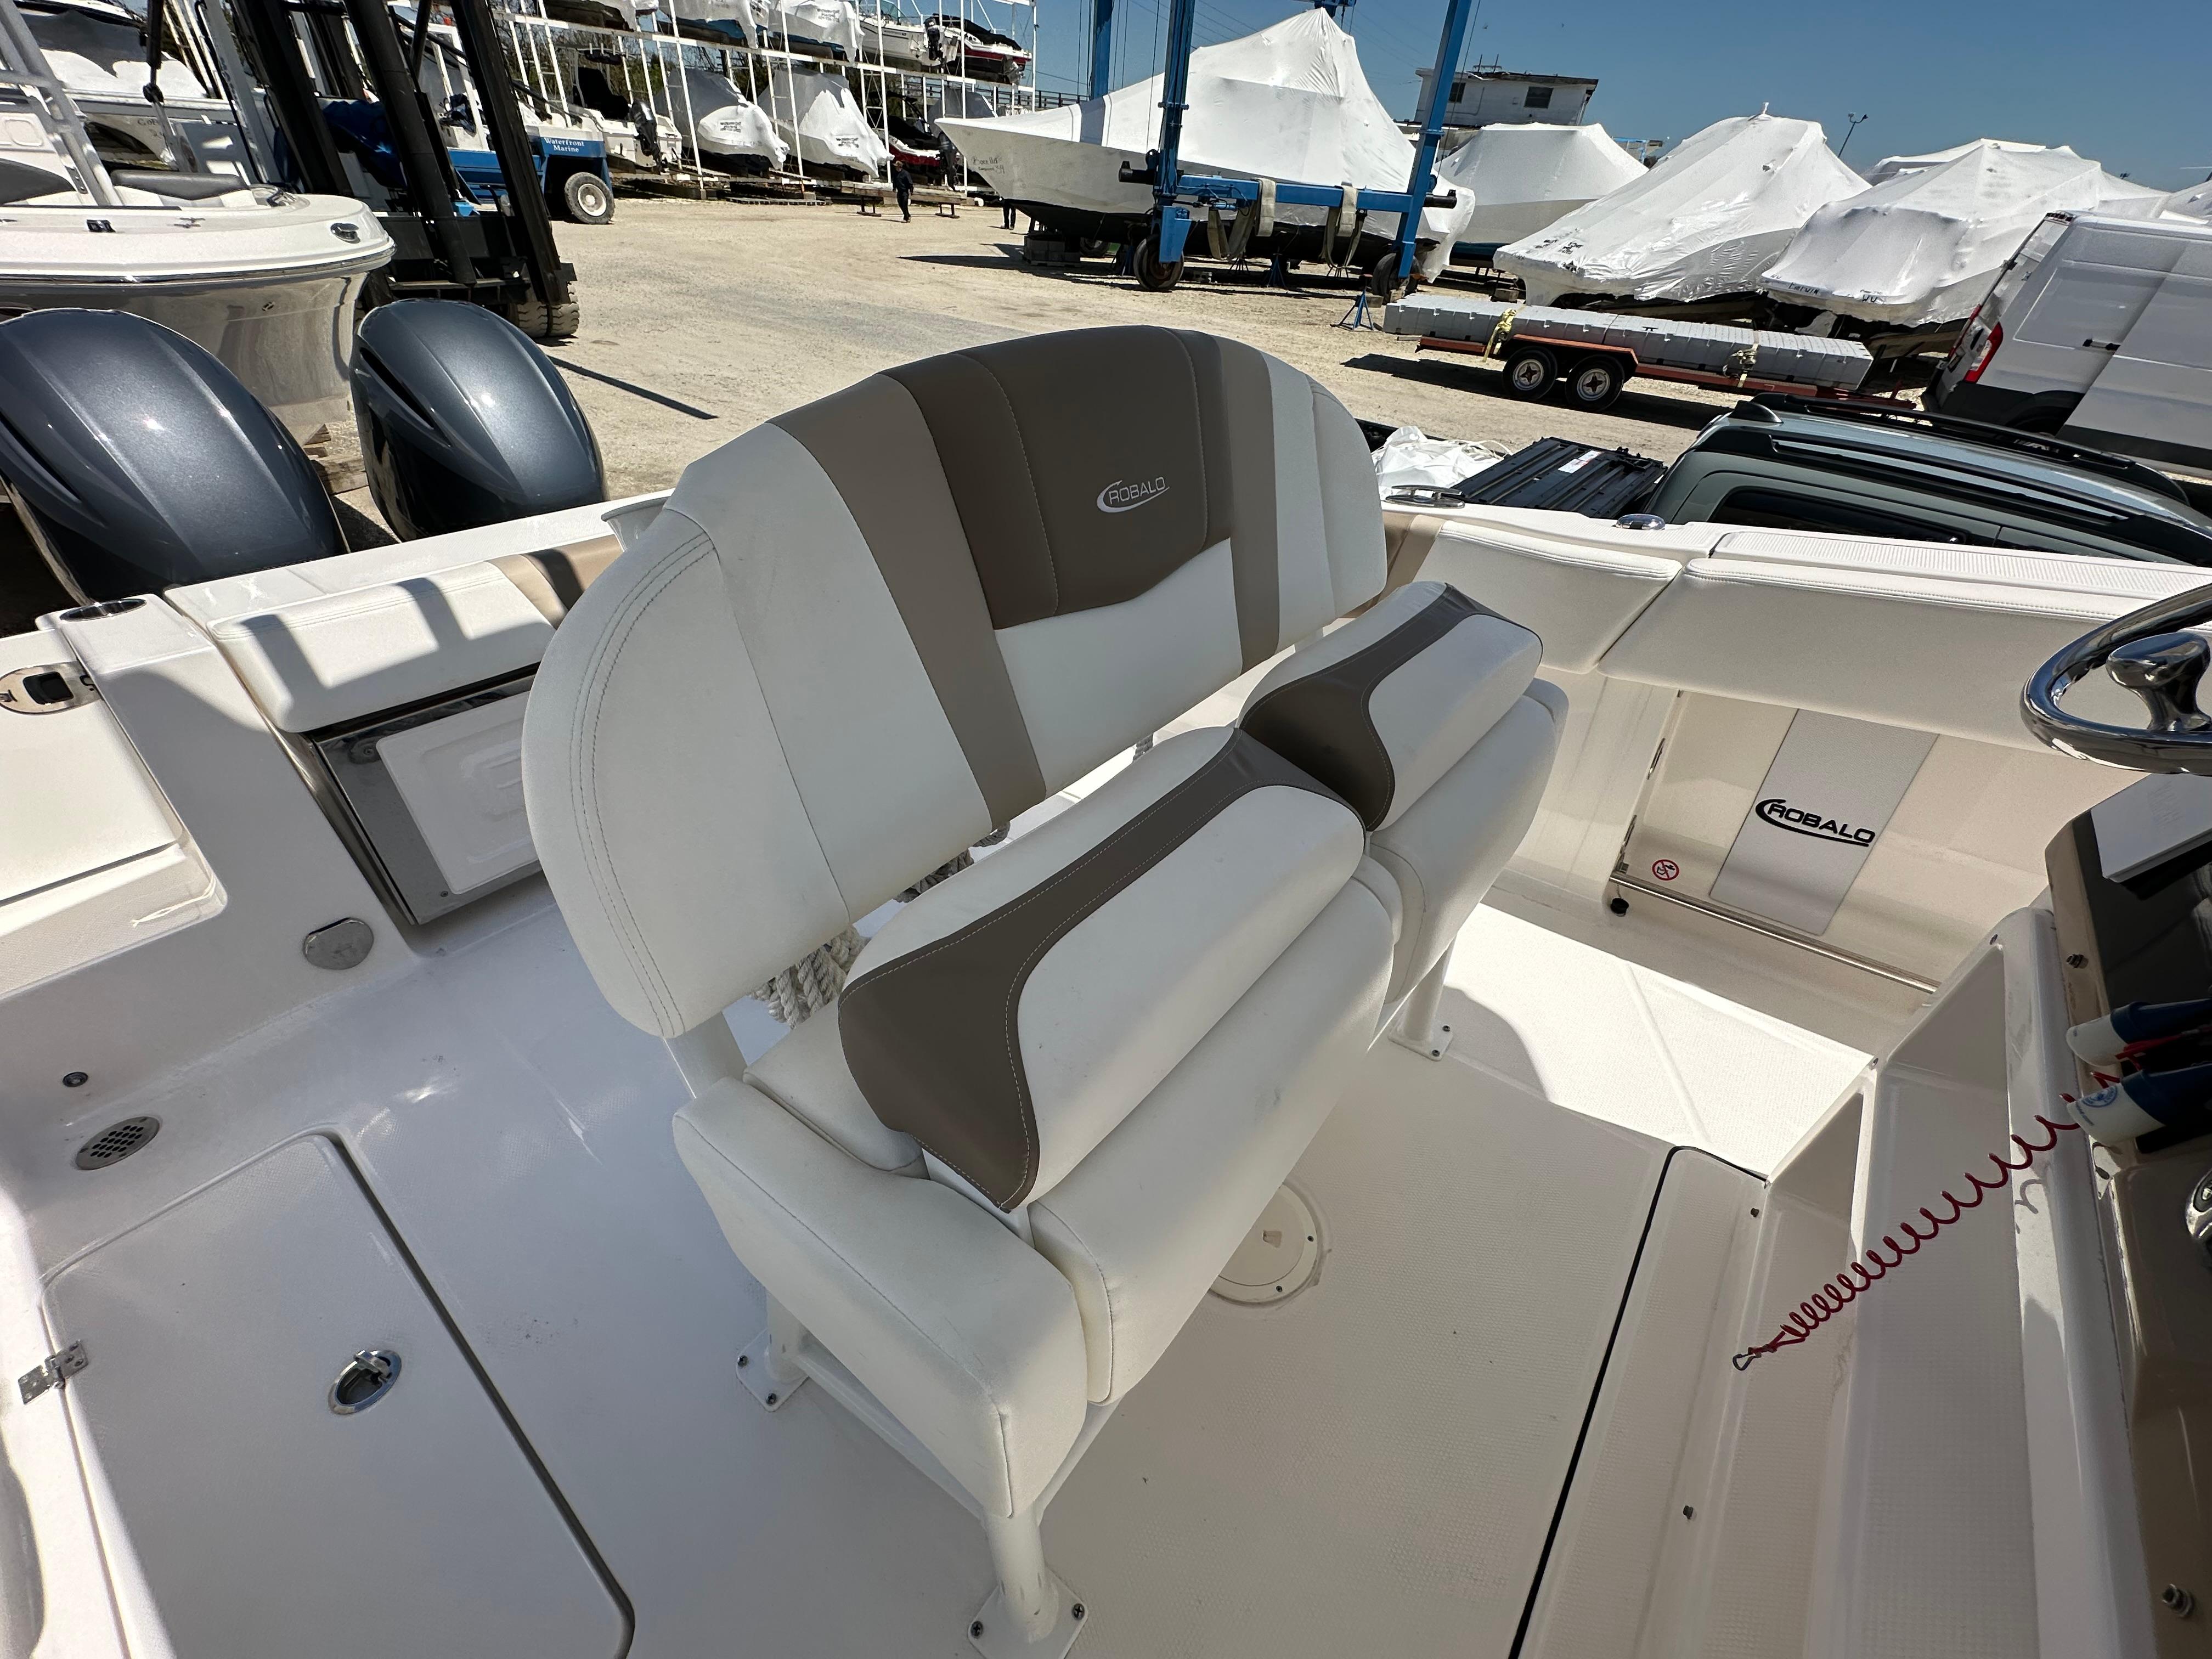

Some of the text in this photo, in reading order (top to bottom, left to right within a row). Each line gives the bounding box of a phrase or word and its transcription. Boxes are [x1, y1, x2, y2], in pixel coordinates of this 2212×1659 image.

[544, 137, 585, 146] Waterfront
[553, 144, 579, 153] Marine
[1108, 476, 1166, 505] ROBALO
[1767, 803, 1876, 844] ROBALO
